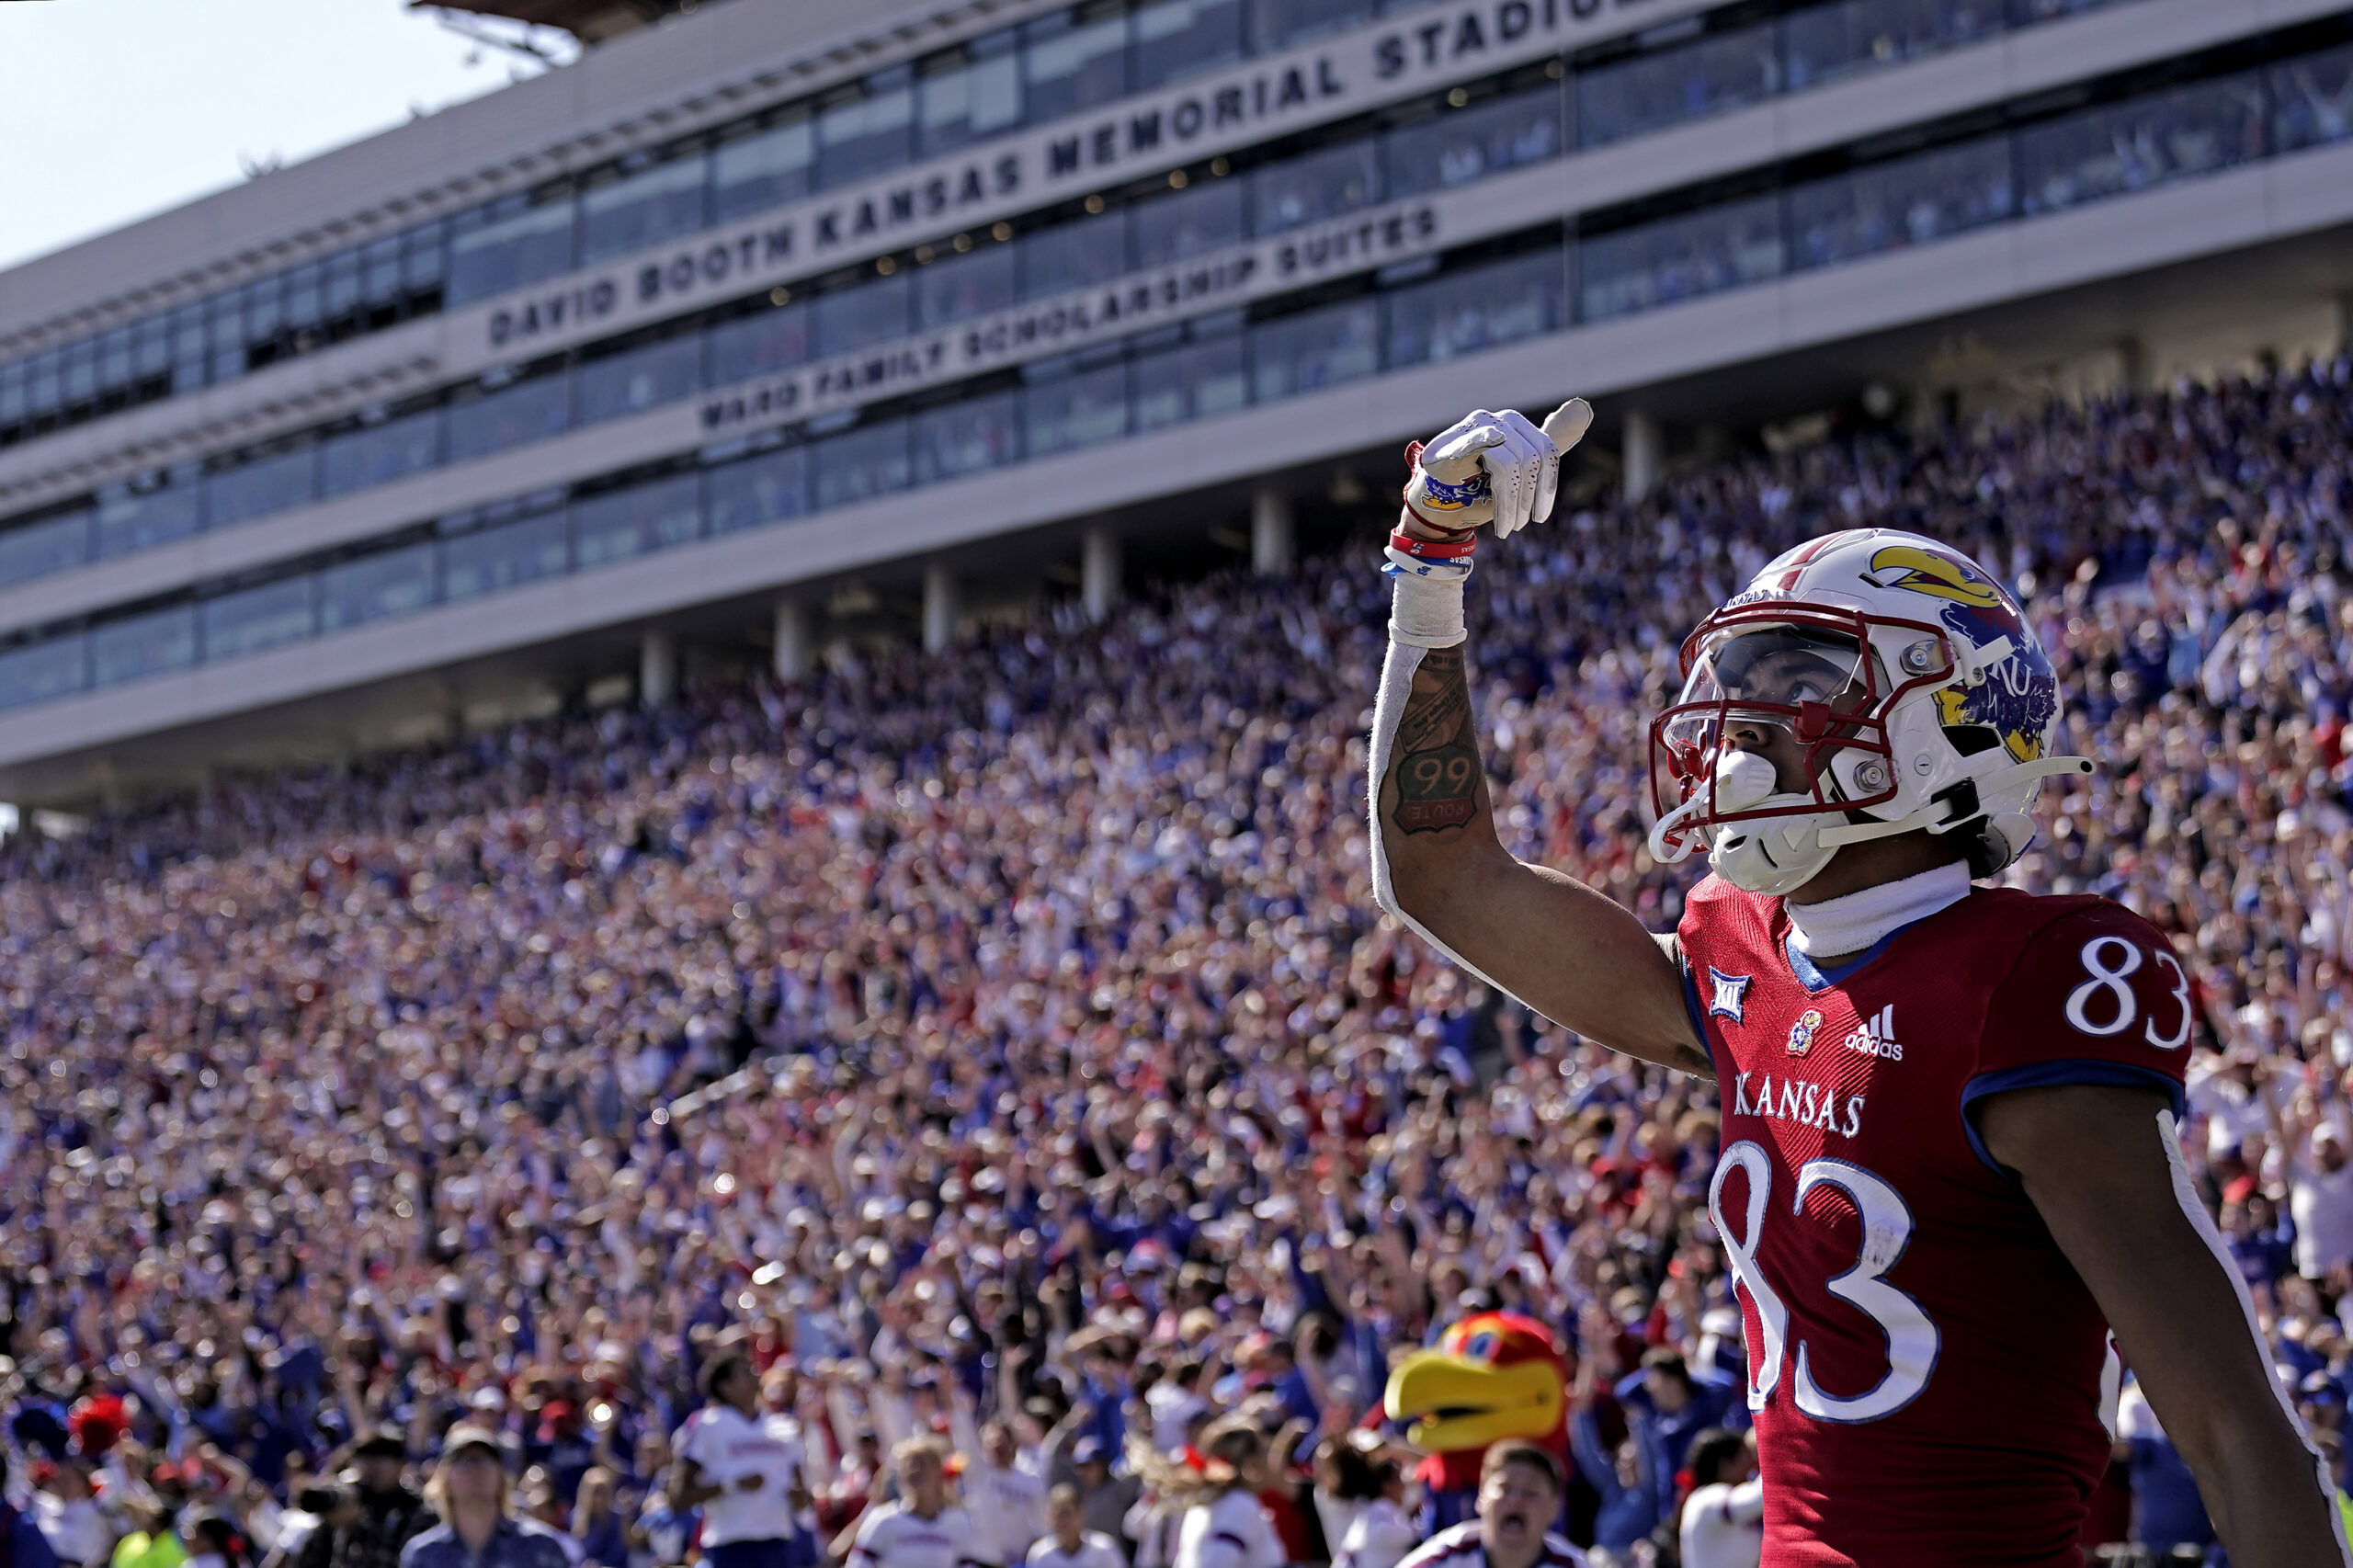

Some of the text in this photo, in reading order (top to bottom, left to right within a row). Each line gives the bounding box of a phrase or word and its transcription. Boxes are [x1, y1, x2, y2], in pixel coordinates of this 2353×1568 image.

[489, 0, 1650, 349] DAVID BOOTH KANSAS MEMORIAL STADI
[700, 207, 1438, 429] WARD FAMILY SCHOLARSHIP SUITES
[1988, 653, 2032, 697] KU
[1845, 1032, 1904, 1062] adidas
[2063, 935, 2193, 1051] 83
[1733, 1071, 1866, 1138] KANSAS
[1708, 1139, 1941, 1425] 83
